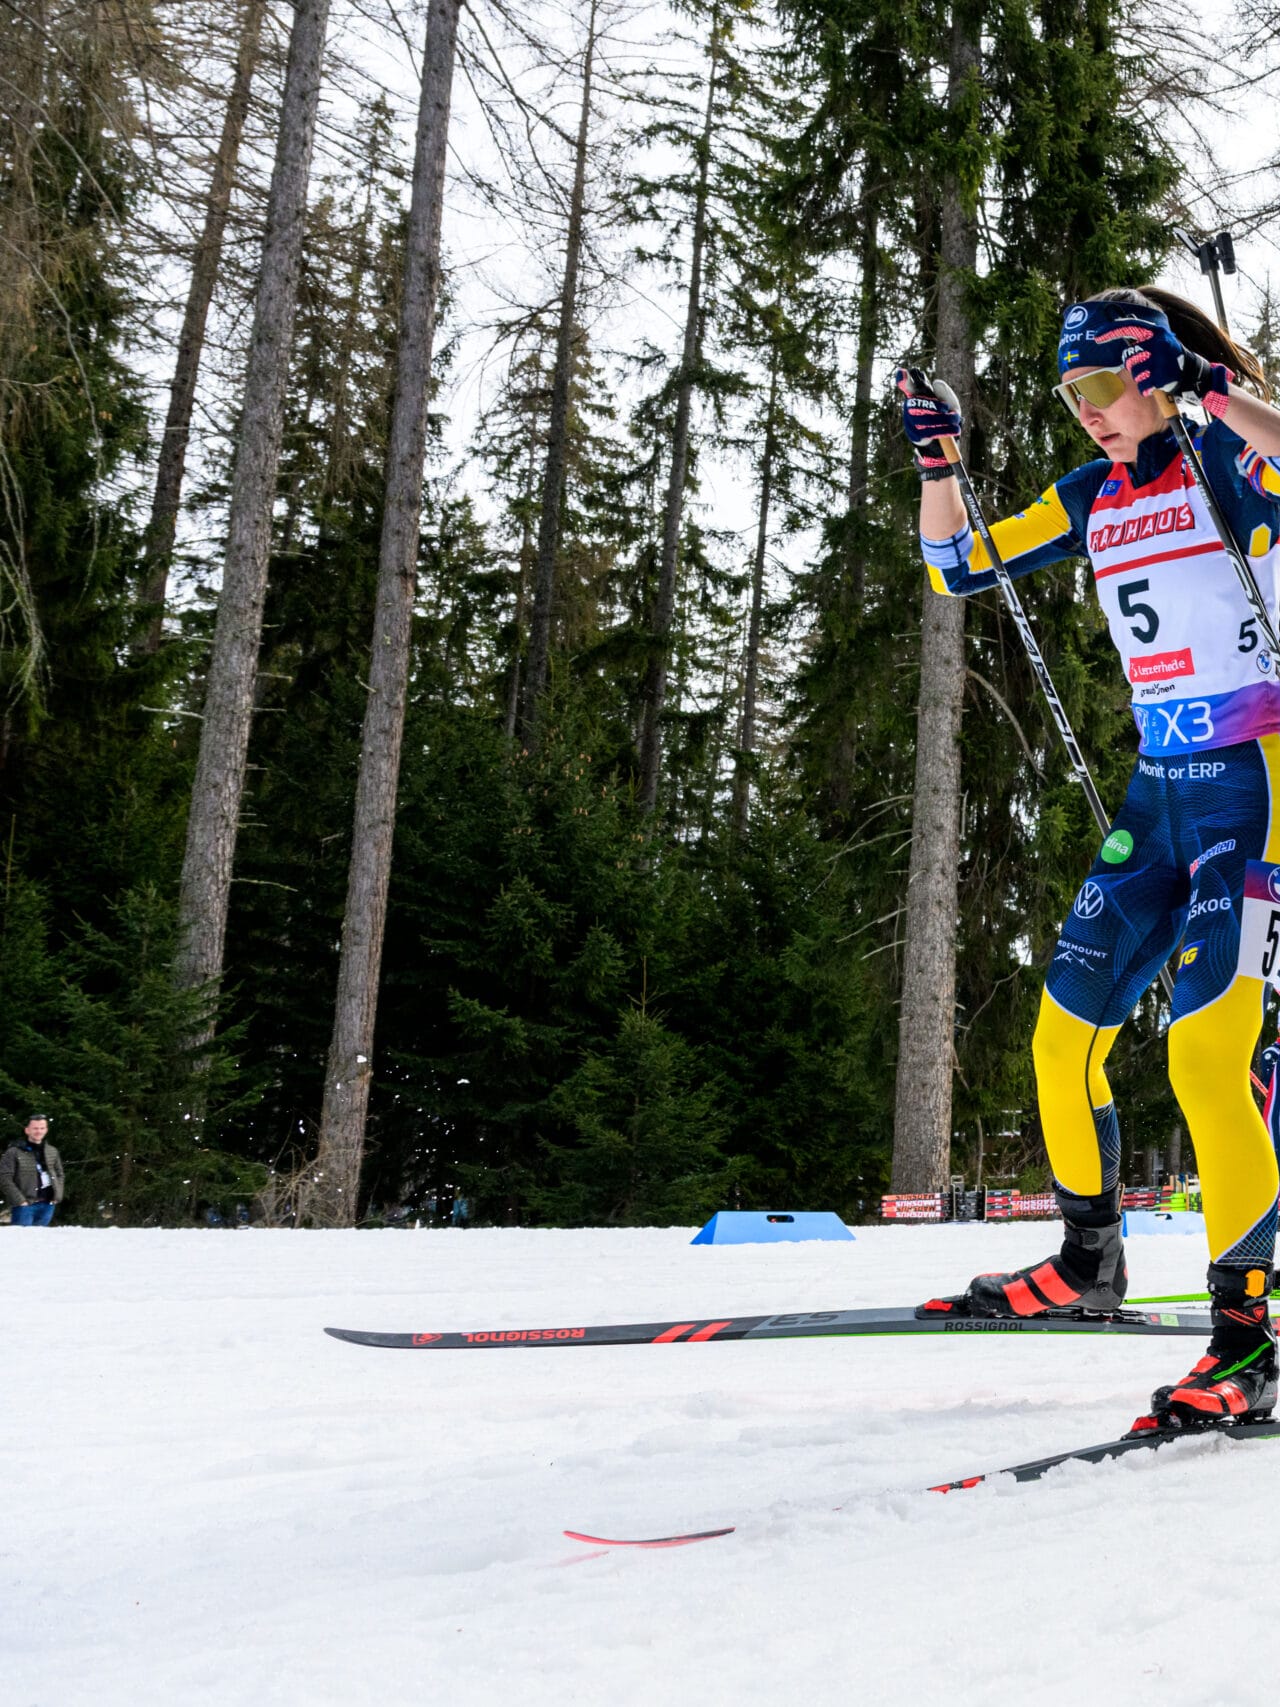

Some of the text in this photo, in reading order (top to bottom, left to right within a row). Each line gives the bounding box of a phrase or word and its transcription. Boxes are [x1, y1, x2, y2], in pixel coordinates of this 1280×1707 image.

[1117, 578, 1160, 644] 5
[1238, 617, 1258, 653] 5
[1157, 701, 1215, 747] X3
[1188, 762, 1226, 778] ERP
[461, 1328, 586, 1343] ROSSIGNOL
[944, 1321, 1025, 1332] ROSSIGNOL
